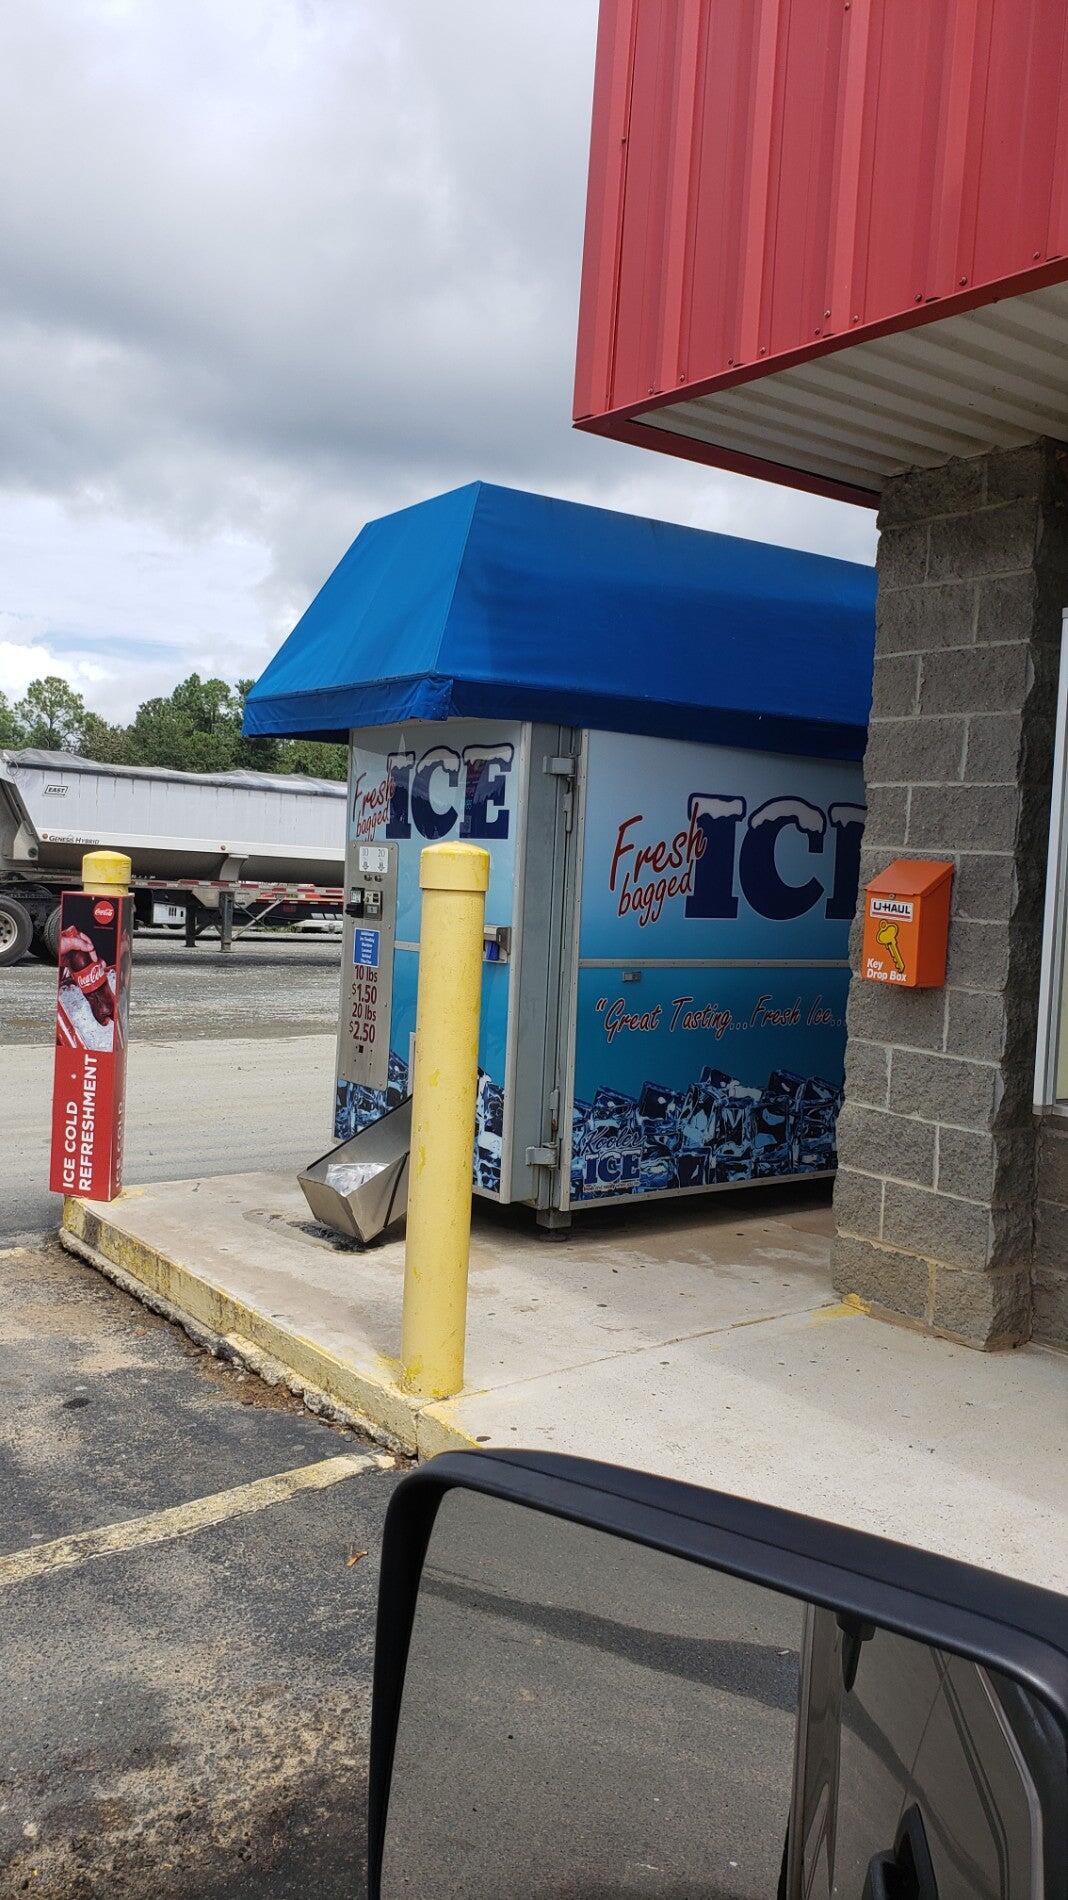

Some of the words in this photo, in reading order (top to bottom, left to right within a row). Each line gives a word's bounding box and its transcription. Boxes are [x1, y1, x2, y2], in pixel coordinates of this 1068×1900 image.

[352, 761, 396, 822] Fresh
[386, 743, 515, 840] ICE
[356, 800, 389, 841] bagged
[609, 801, 708, 891] Fresh
[618, 859, 693, 927] bagged
[873, 901, 911, 914] U-HAUL
[354, 965, 365, 980] 10
[366, 966, 378, 982] lbs
[866, 958, 884, 971] Key
[866, 968, 888, 981] Drop
[889, 971, 907, 982] Box
[351, 982, 378, 1005] $1.50
[351, 1002, 363, 1019] 20
[364, 1003, 377, 1021] lbs
[750, 994, 801, 1027] Fresh
[348, 1020, 376, 1044] $2.50
[65, 1101, 78, 1153] COLD
[78, 1053, 98, 1191] REFRESHMENT
[62, 1157, 76, 1189] ICE
[584, 1149, 642, 1184] ICE
